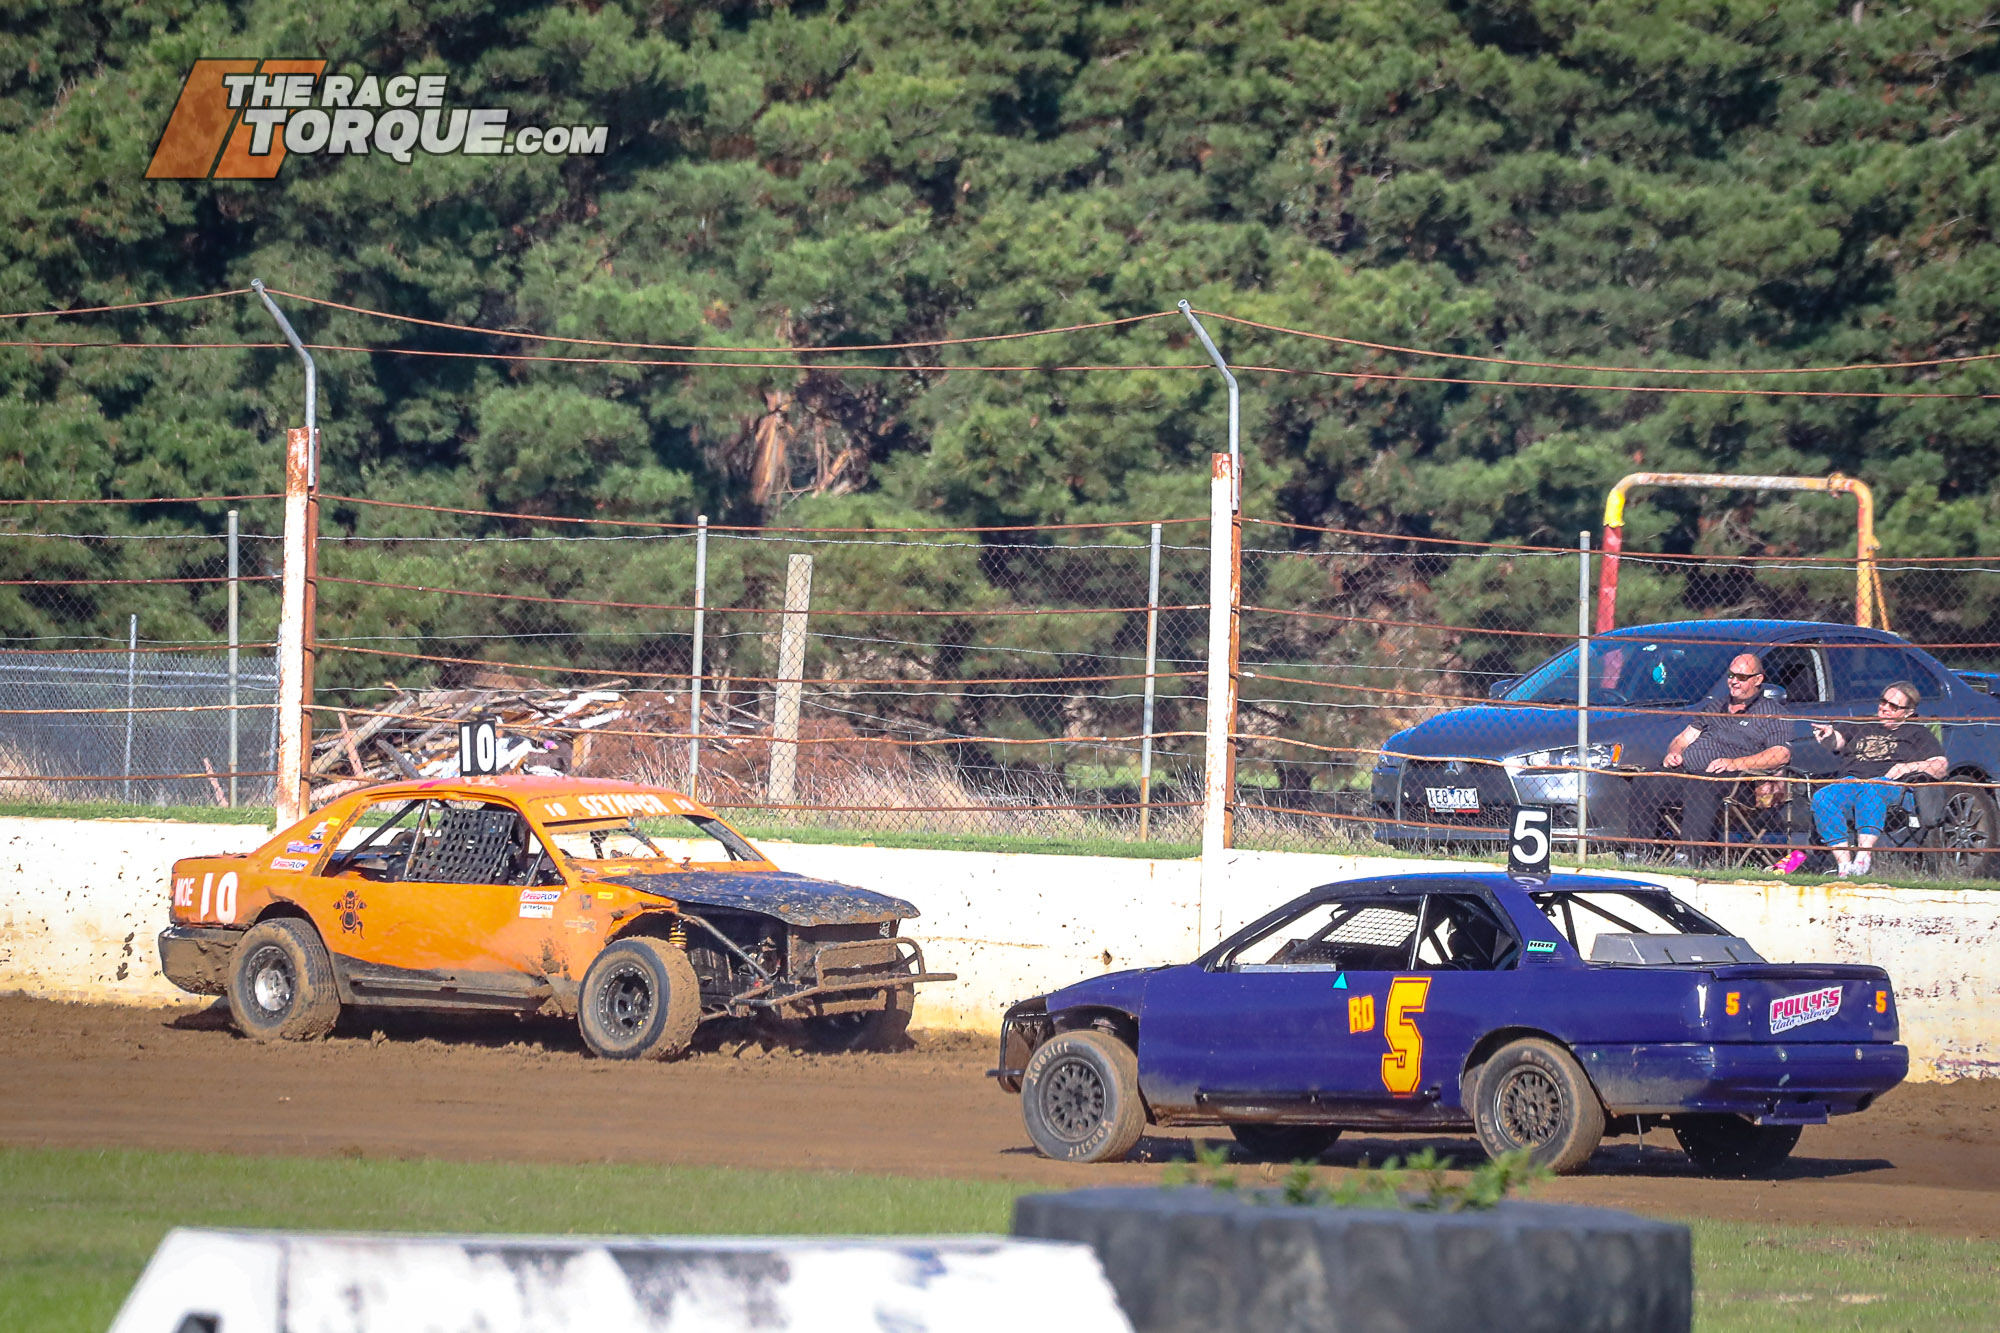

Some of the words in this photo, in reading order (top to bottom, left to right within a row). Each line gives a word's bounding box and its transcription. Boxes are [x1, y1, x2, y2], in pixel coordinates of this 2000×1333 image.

[461, 723, 495, 772] 10
[544, 802, 568, 817] 10
[578, 793, 670, 817] SEYMOUR
[1511, 810, 1549, 864] 5
[200, 871, 239, 925] 10
[1725, 992, 1741, 1015] 5
[1771, 989, 1840, 1020] POLLY'S
[1875, 990, 1887, 1013] 5
[1772, 1017, 1796, 1032] Auto
[1798, 1005, 1838, 1024] Salvage
[1348, 994, 1375, 1034] RD
[1381, 976, 1432, 1099] 5
